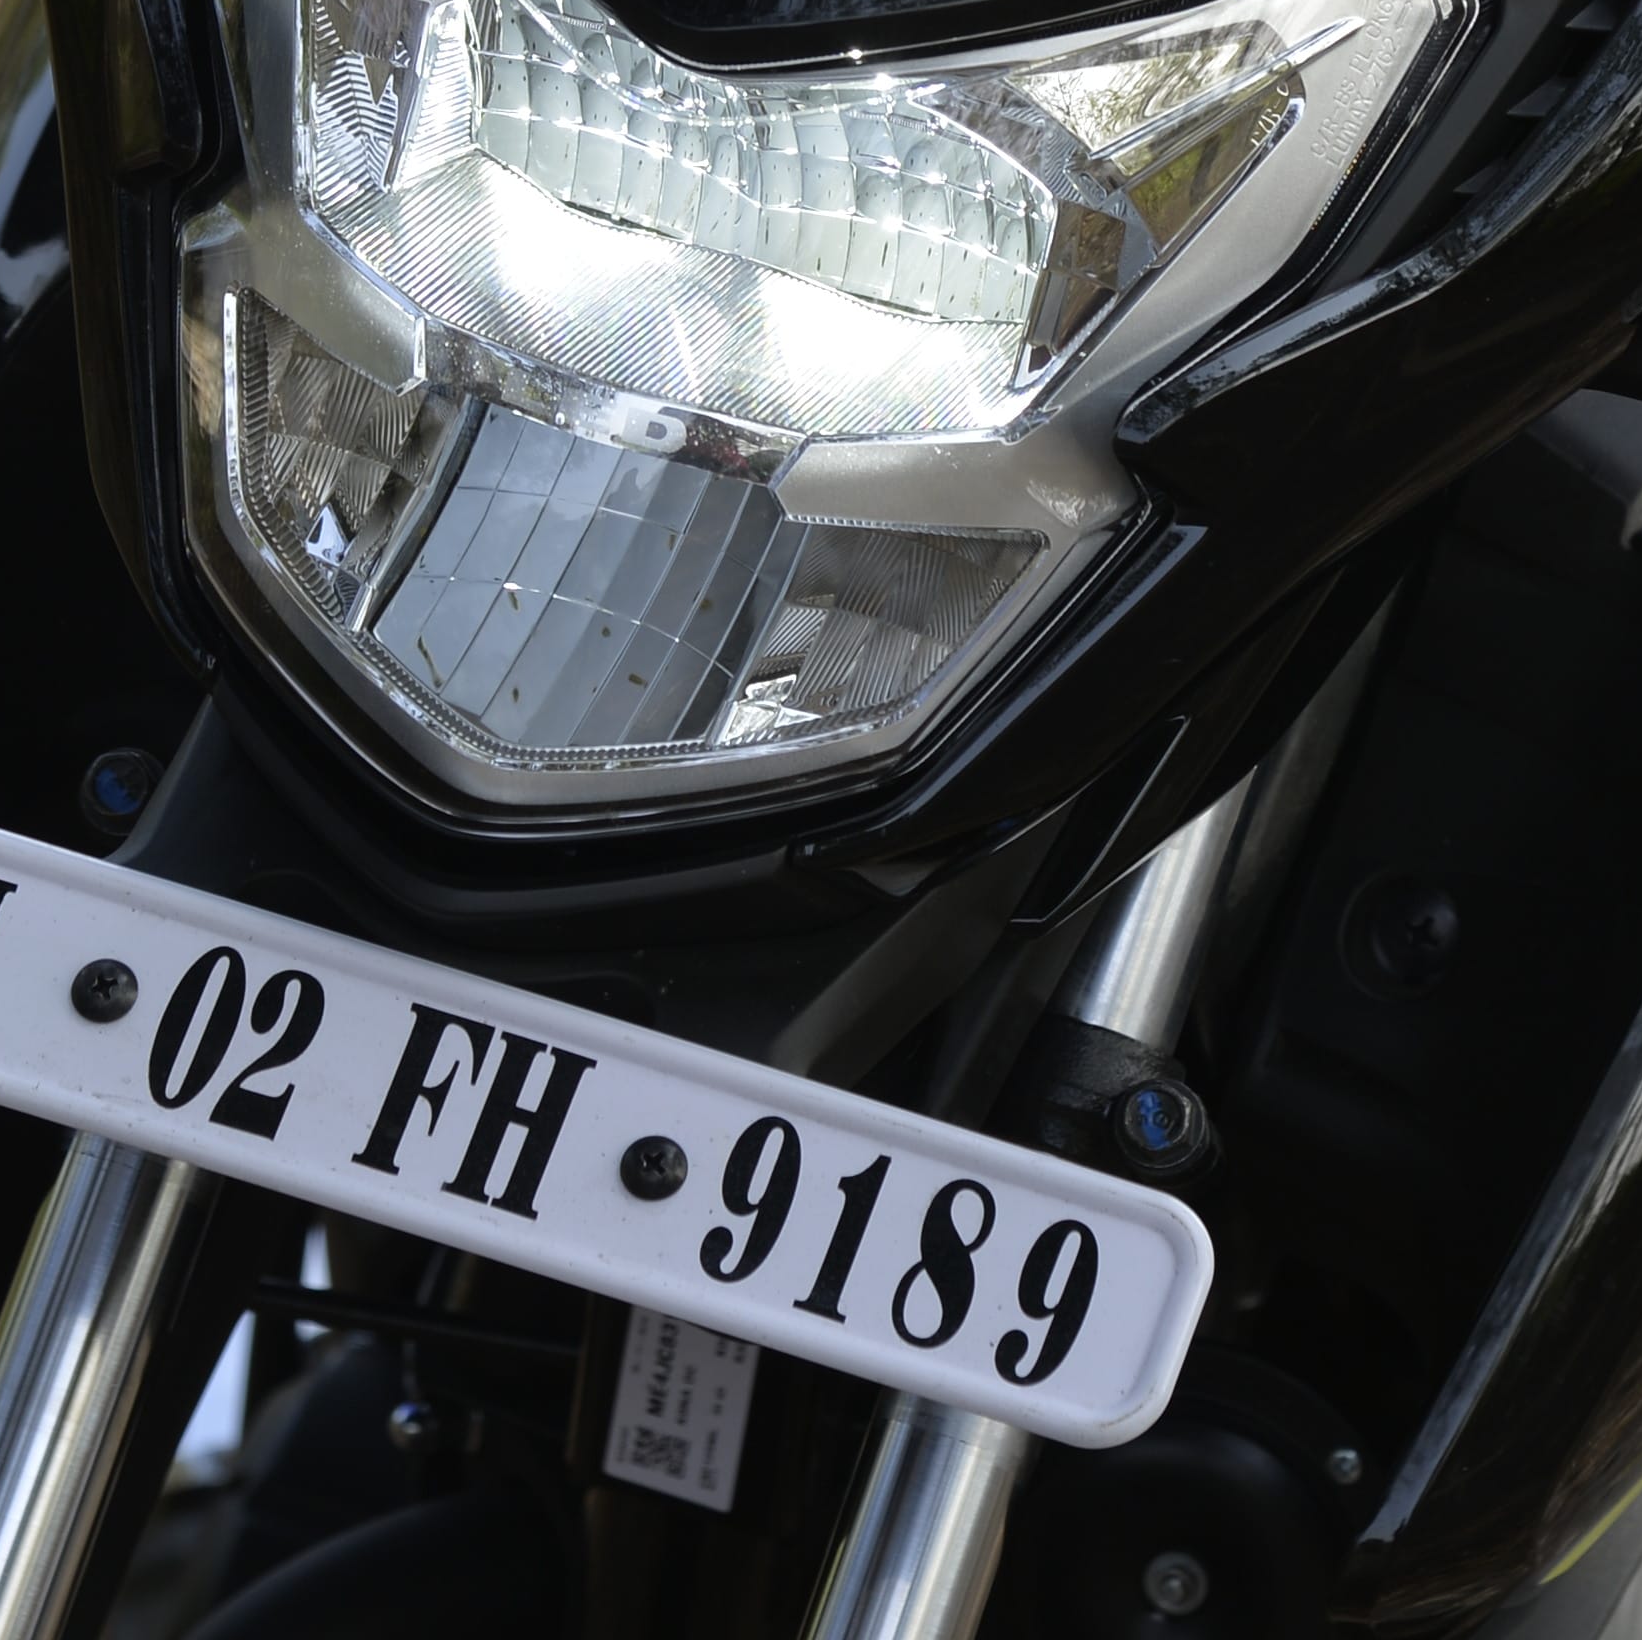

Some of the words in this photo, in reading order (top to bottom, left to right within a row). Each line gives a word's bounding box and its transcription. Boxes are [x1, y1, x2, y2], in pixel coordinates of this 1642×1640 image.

[1326, 92, 1375, 169] LUMAX
[145, 944, 325, 1142] 02
[352, 1003, 597, 1220] FH
[699, 1116, 1098, 1386] 9189
